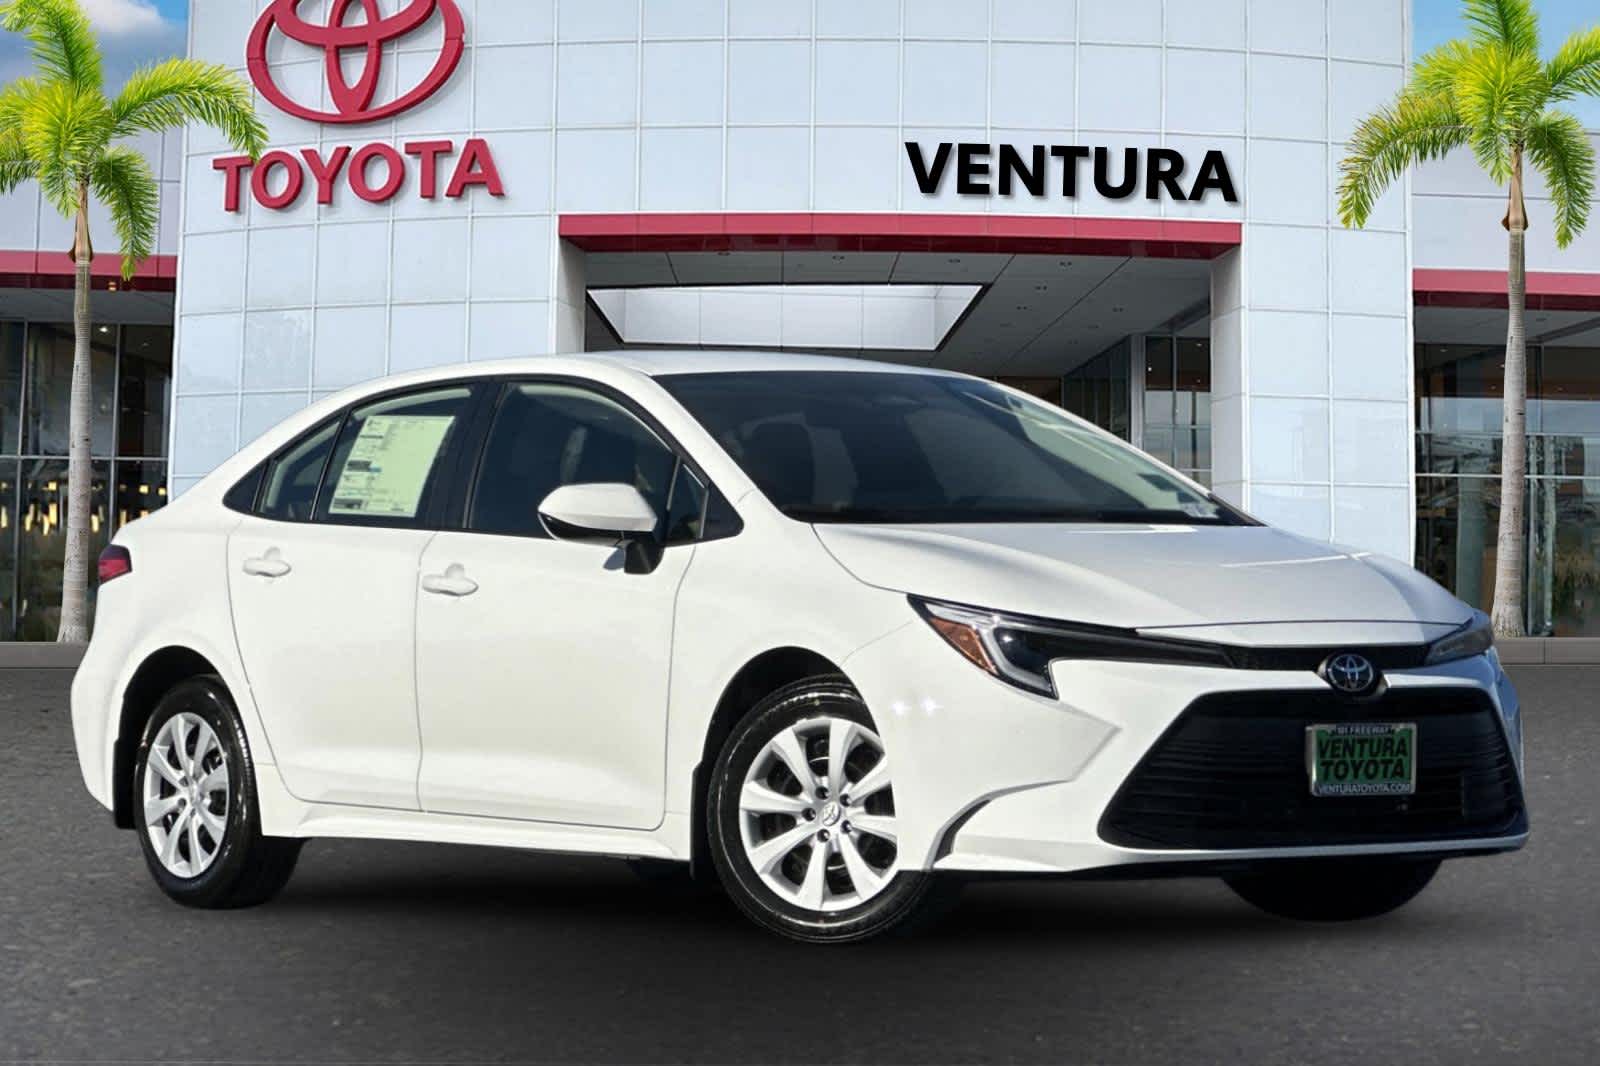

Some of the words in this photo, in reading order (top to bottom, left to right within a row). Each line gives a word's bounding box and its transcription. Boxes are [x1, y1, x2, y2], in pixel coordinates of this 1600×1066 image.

[212, 138, 505, 212] TOYOTA
[904, 142, 1239, 203] VENTURA
[1318, 737, 1408, 758] VENTURA
[1320, 758, 1405, 780] TOYOTA
[1319, 783, 1411, 793] VENTURATOYOTA.COM
